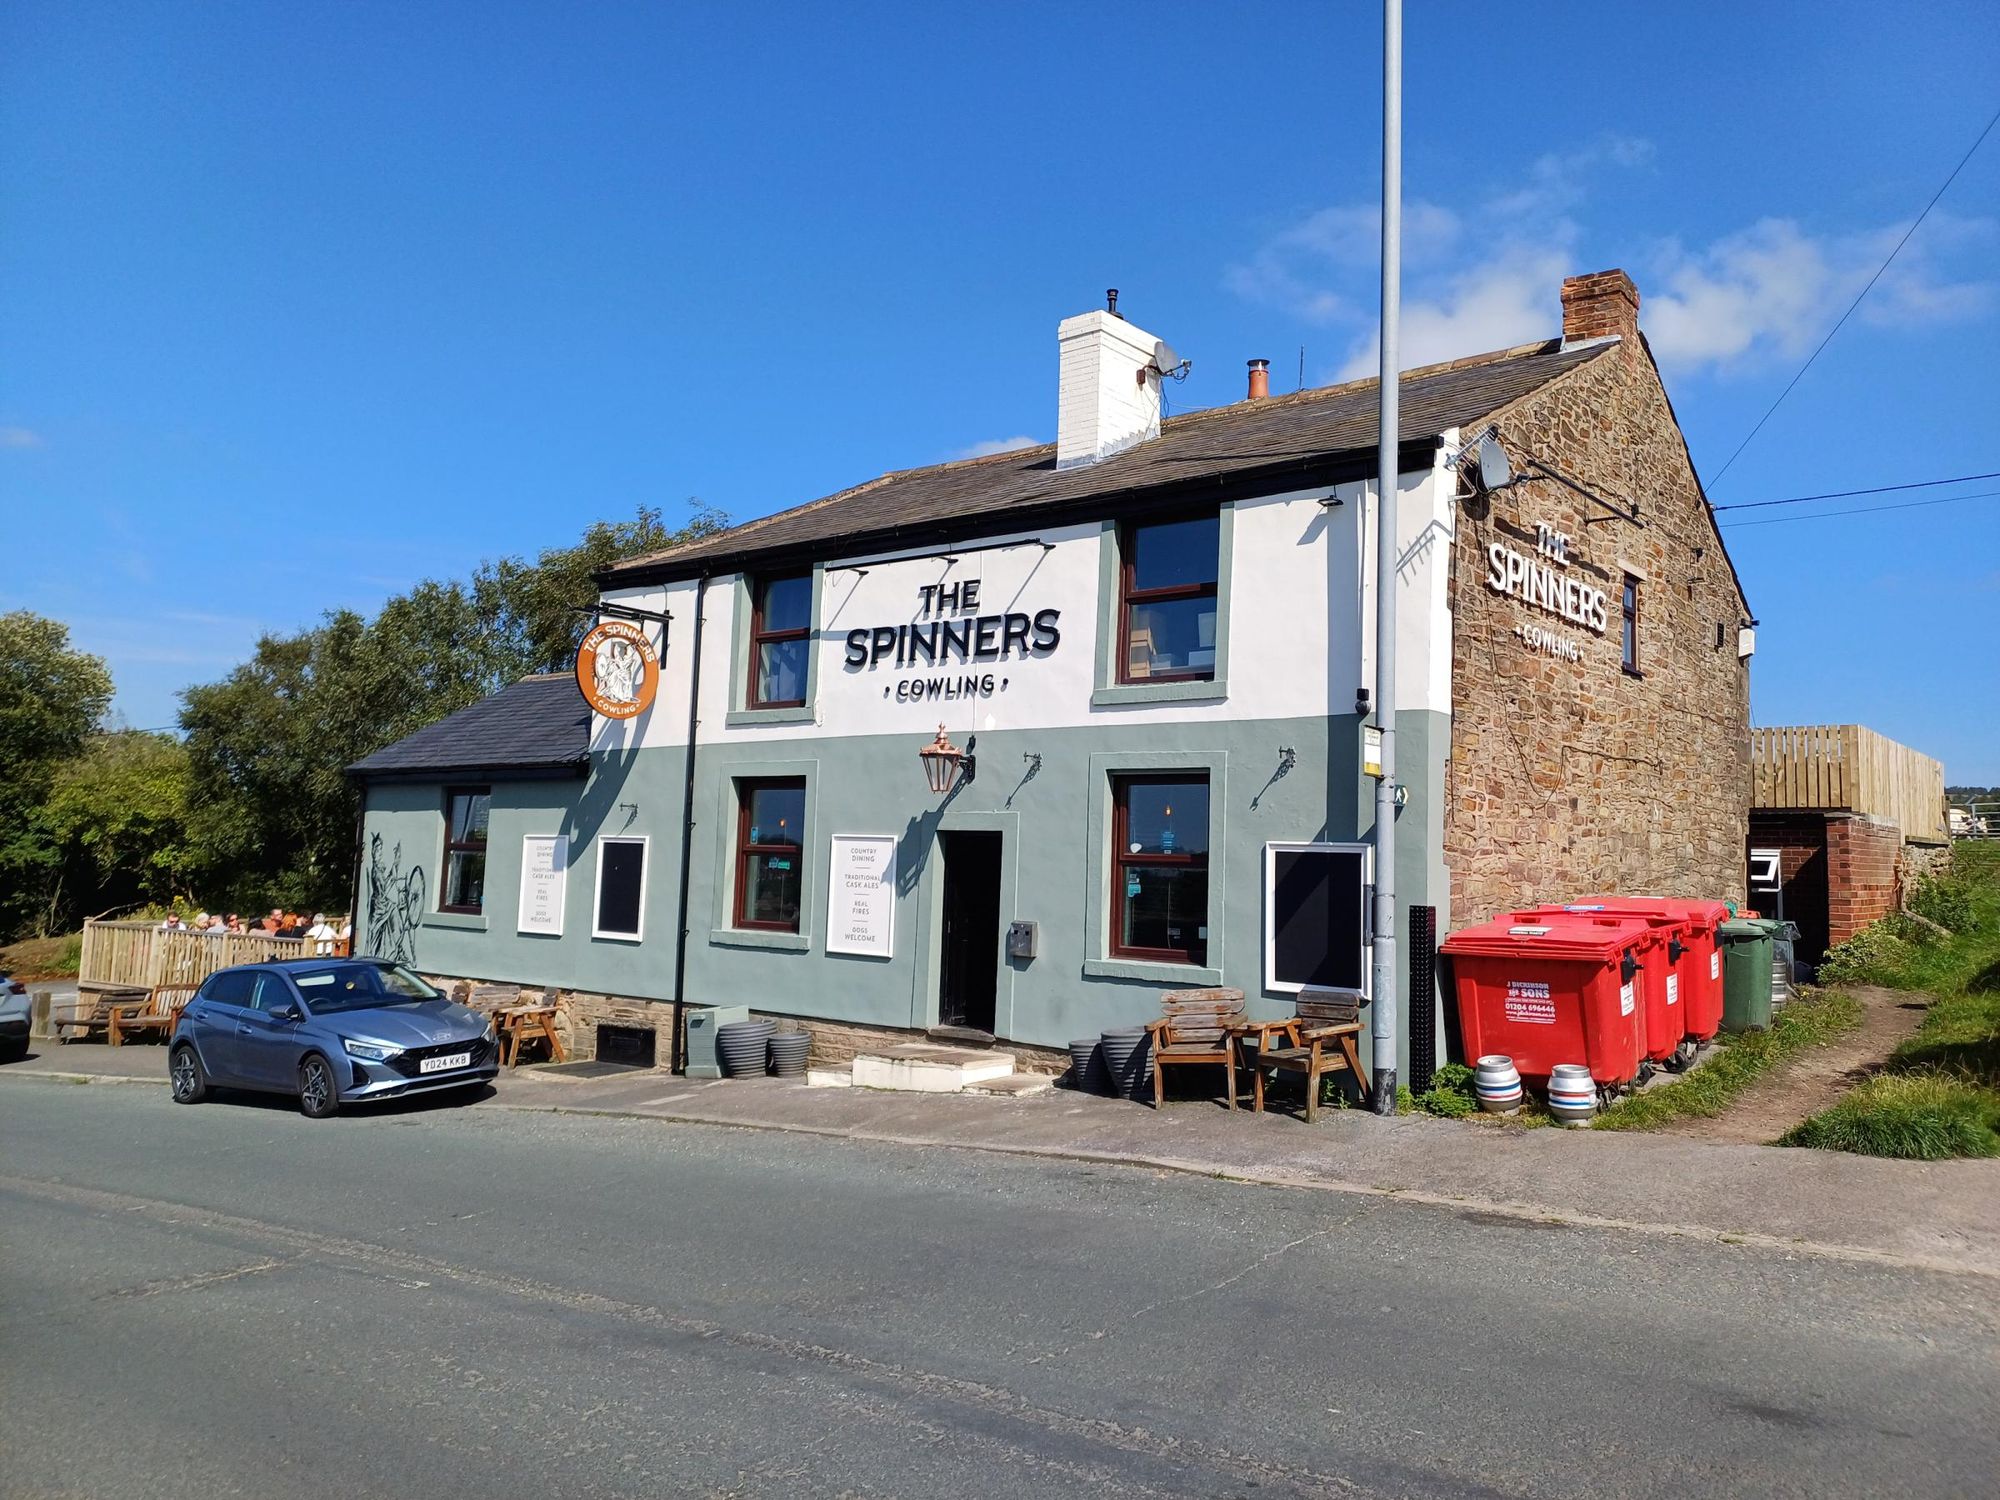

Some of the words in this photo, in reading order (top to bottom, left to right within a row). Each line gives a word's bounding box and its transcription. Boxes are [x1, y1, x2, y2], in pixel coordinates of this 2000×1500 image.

[1536, 520, 1570, 566] THE
[920, 579, 981, 613] THE
[1488, 543, 1607, 632] SPINNERS
[583, 630, 606, 652] THE
[605, 624, 655, 662] SPINNERS
[845, 609, 1061, 666] SPINNERS
[1524, 624, 1577, 661] COWLING
[898, 674, 994, 696] COWLING
[597, 700, 636, 714] COWLING
[852, 907, 869, 915] FIRES
[845, 934, 875, 942] WELCOME
[1521, 988, 1550, 999] SONS
[424, 1058, 447, 1070] YD24
